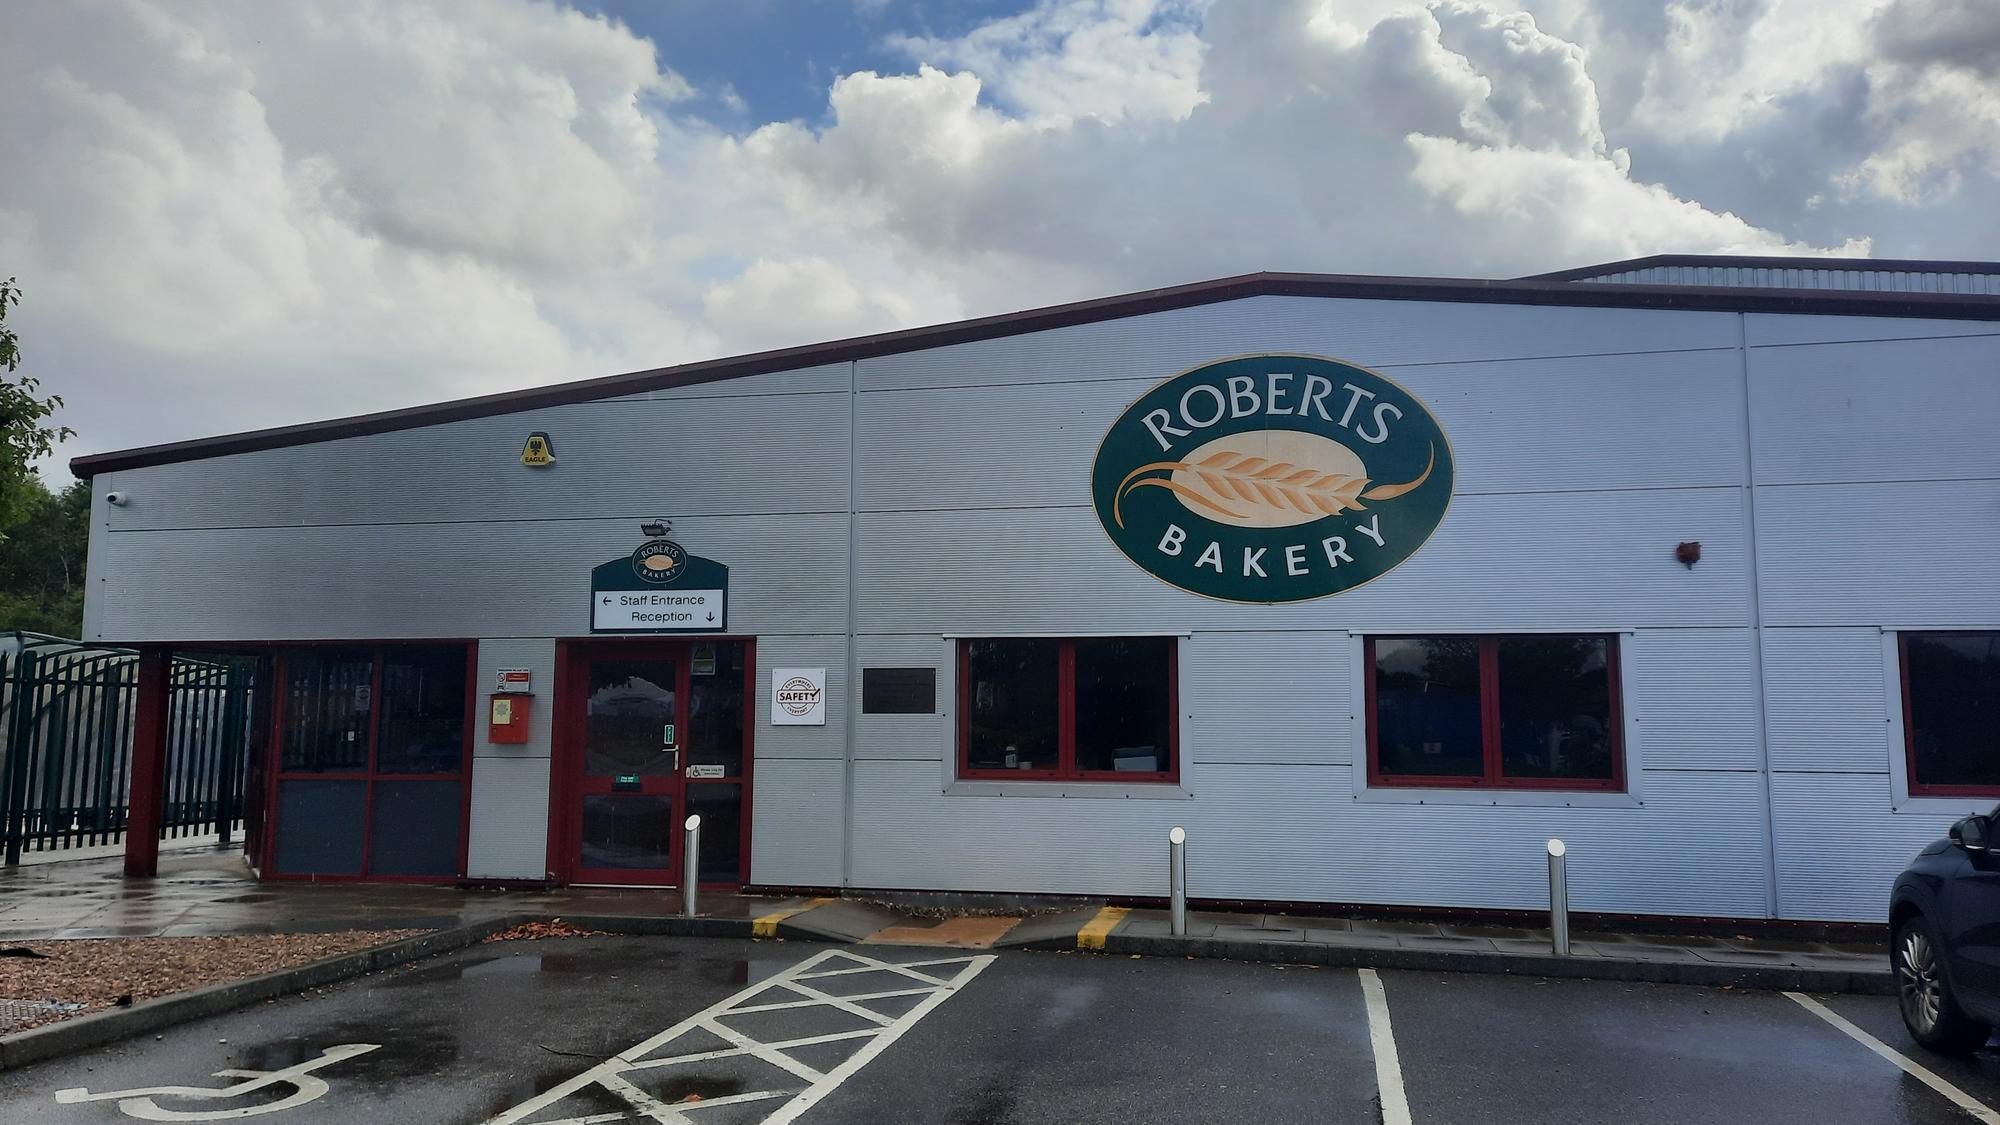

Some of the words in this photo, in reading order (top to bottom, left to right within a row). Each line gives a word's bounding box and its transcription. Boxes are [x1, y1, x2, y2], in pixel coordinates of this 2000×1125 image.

[1141, 373, 1404, 452] ROBERTS
[641, 545, 679, 558] ROBERTS
[1157, 514, 1386, 578] BAKERY
[642, 568, 676, 578] BAKERY
[620, 595, 648, 606] Staff
[651, 595, 705, 605] Entrance
[631, 611, 692, 623] Reception
[779, 691, 817, 700] SAFETY
